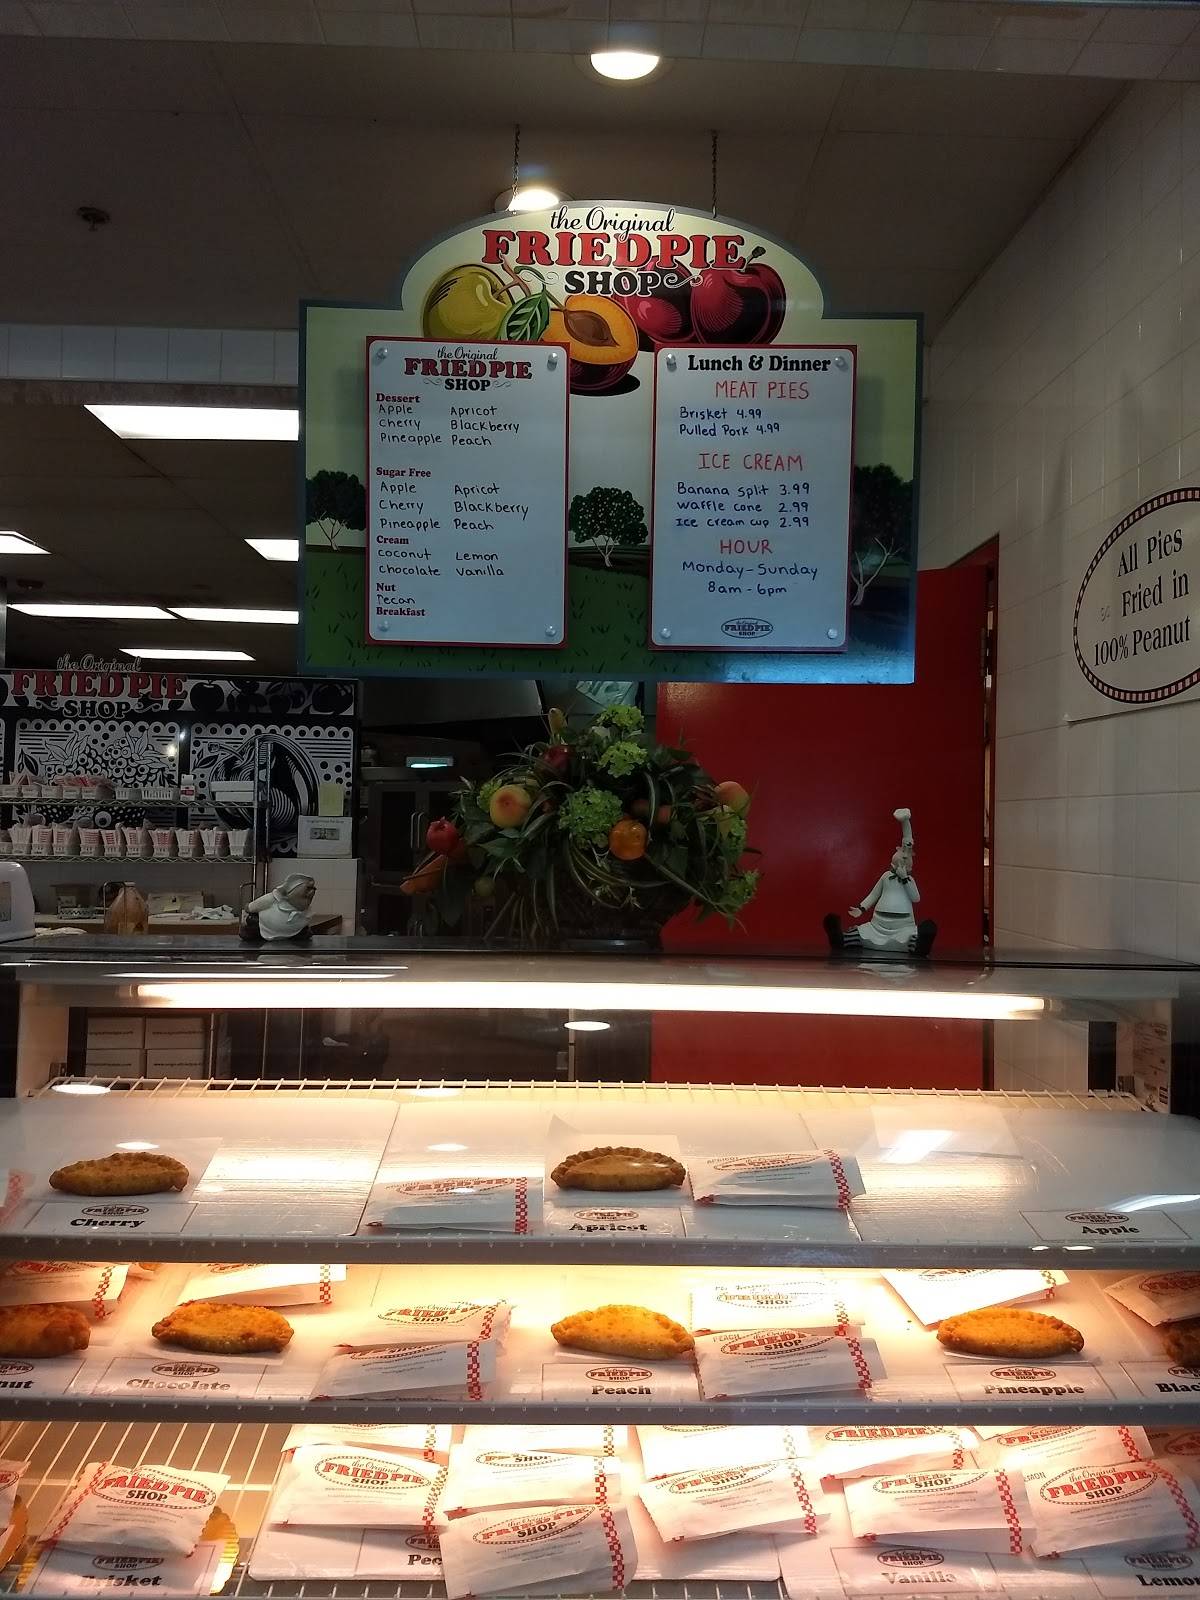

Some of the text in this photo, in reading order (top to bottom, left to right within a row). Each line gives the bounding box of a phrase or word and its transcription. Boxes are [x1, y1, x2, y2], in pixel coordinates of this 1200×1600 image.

[550, 206, 675, 242] the Original
[564, 270, 661, 296] SHOP
[437, 346, 498, 361] the Original
[687, 354, 831, 372] Lunch & Dinner
[444, 378, 491, 391] SHOP
[715, 380, 810, 400] MEAT PIES
[376, 392, 421, 403] Dessert
[378, 404, 413, 419] Apple
[450, 405, 498, 420] Apricot
[679, 406, 762, 419] Brisket 4.99
[379, 418, 421, 430] Cherry
[450, 419, 520, 433] Blackberry
[679, 422, 780, 437] Pulled Pork 4.99
[380, 432, 442, 446] Pineapple
[451, 434, 492, 446] Peach
[698, 453, 803, 471] ICE CREAM
[376, 467, 432, 479] Sugar Free
[380, 481, 417, 496] Apple
[454, 482, 501, 498] Apricot
[677, 482, 730, 496] Banana
[779, 482, 810, 496] 3.99
[379, 499, 424, 515] Cherry
[454, 501, 529, 520] Blackberry
[778, 502, 809, 513] 2.99
[380, 518, 441, 532] Pineapple
[453, 518, 495, 531] Peach
[675, 518, 699, 528] Ice
[750, 519, 770, 529] cup
[779, 517, 809, 528] 2.99
[376, 535, 409, 546] Cream
[720, 539, 773, 554] HOUR
[455, 552, 499, 561] Lemon
[1117, 528, 1183, 578] All Pies
[376, 583, 396, 592] Nut
[708, 581, 742, 593] 8am
[757, 583, 787, 597] 6pm
[1121, 569, 1189, 617] Fried in
[377, 594, 415, 605] Pecan
[376, 607, 426, 617] Breakfast
[1094, 615, 1191, 667] 100% Peanut
[57, 653, 142, 676] the Original
[63, 701, 131, 719] SHOP
[70, 1218, 145, 1228] Cherry
[568, 1223, 648, 1232] Apricot
[1082, 1225, 1140, 1235] Apple
[764, 1339, 803, 1351] SHOP
[127, 1379, 231, 1391] Chocolate
[592, 1385, 651, 1395] Peach
[984, 1384, 1085, 1396] Pineapple
[1155, 1382, 1200, 1392] Blac
[712, 1473, 747, 1486] SHOP
[914, 1477, 952, 1488] SHOP
[126, 1489, 168, 1502] SHOP
[1085, 1485, 1123, 1500] SHOP
[517, 1521, 556, 1538] SHOP
[881, 1571, 957, 1585] Vanilla
